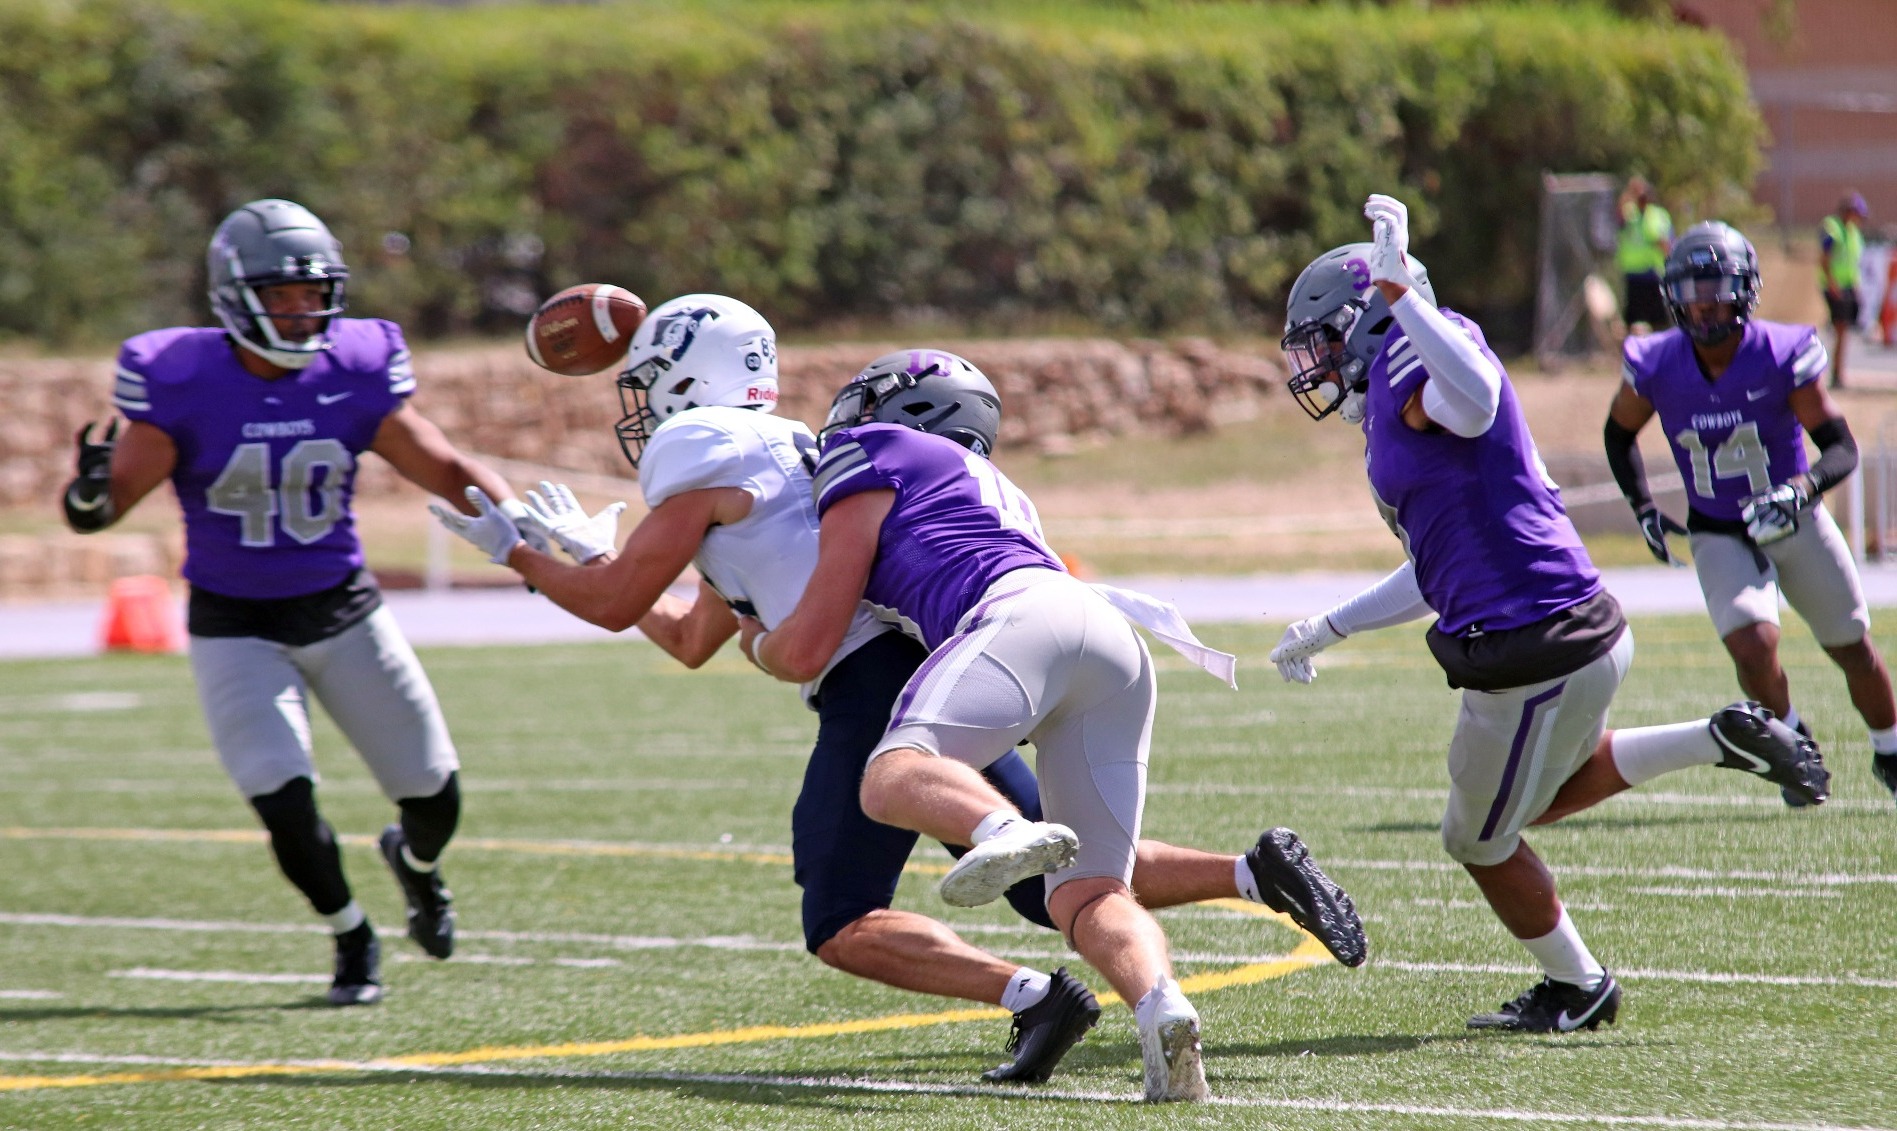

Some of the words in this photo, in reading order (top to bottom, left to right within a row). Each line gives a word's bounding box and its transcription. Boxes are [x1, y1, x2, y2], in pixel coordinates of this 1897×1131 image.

[241, 419, 316, 438] COWBOYS
[1691, 409, 1743, 430] COWBOYS
[1675, 420, 1772, 499] 14
[204, 438, 353, 547] 40
